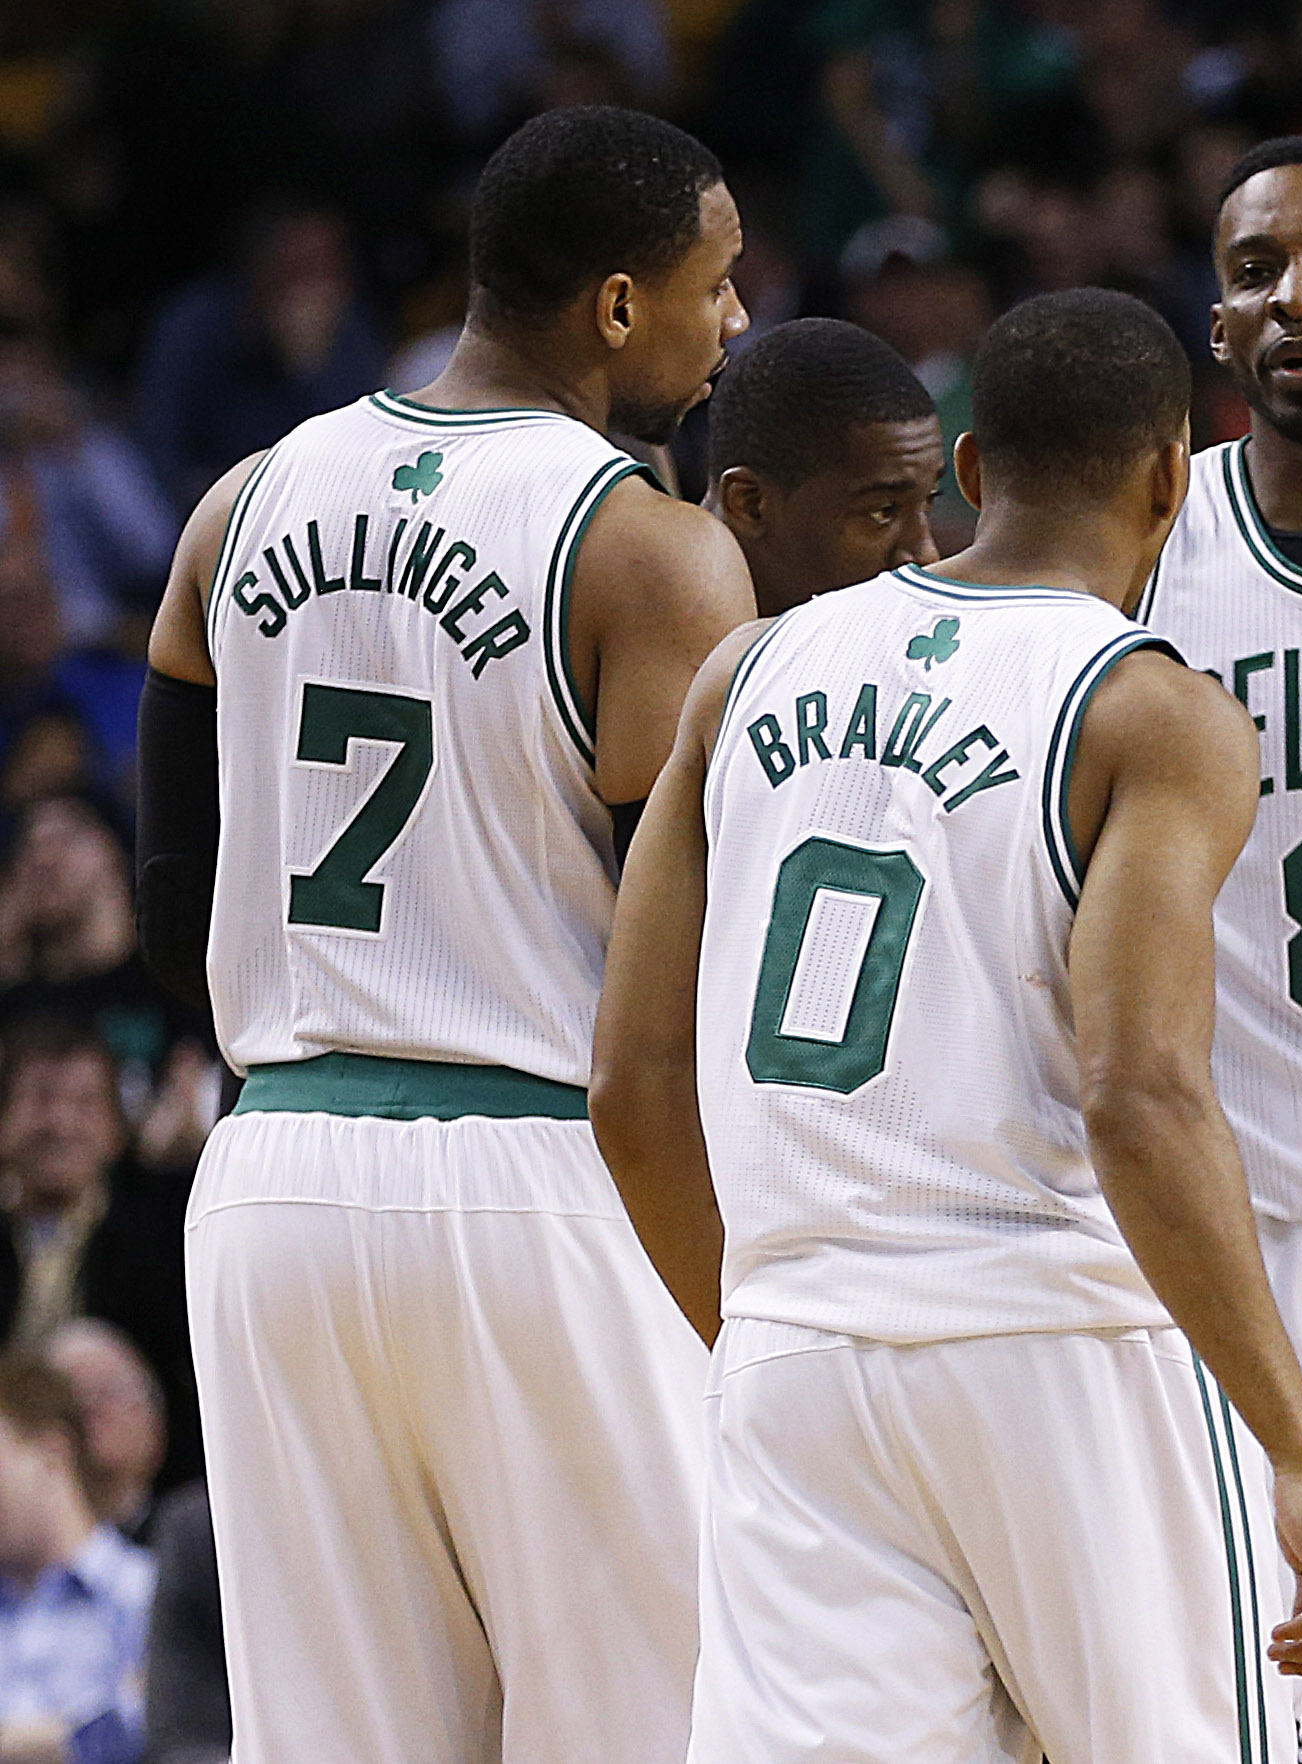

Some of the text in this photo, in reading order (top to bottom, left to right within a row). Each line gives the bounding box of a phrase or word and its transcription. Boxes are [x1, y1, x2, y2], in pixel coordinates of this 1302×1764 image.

[233, 514, 530, 680] SULLINGER
[287, 682, 432, 933] 7
[746, 683, 1021, 814] BRADLEY
[745, 836, 925, 1095] 0
